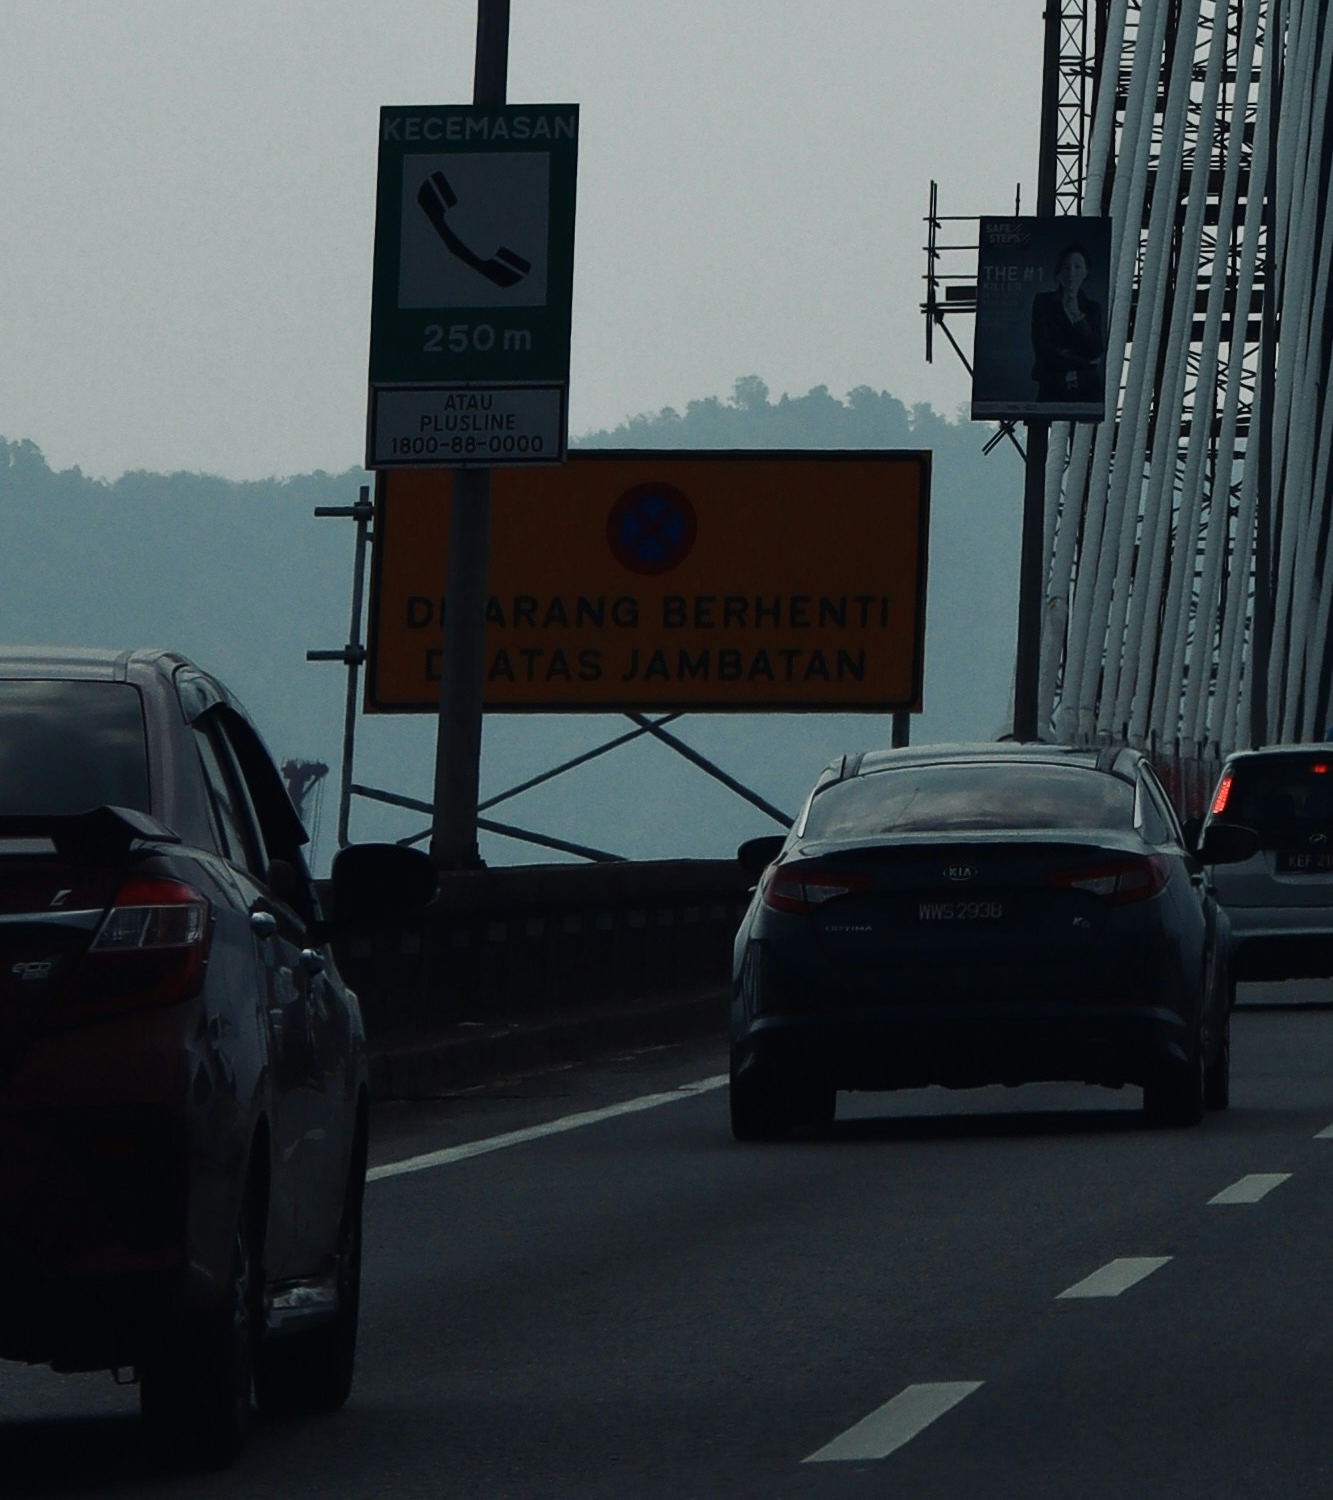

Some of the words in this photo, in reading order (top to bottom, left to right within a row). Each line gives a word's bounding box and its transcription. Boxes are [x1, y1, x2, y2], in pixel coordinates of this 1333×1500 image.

[383, 115, 576, 141] KECEMASAN
[986, 223, 1011, 233] SAFE
[990, 234, 1020, 244] STEPS
[984, 266, 1018, 281] THE
[1024, 266, 1043, 281] #1
[423, 323, 495, 353] 250
[503, 327, 531, 351] m
[444, 394, 493, 412] ATAU
[420, 413, 515, 432] PLUSLINE
[391, 434, 544, 454] 1800-88-0000
[407, 596, 640, 628] DIARANG
[663, 596, 889, 628] BERHENTI
[488, 648, 603, 682] ATAS
[621, 648, 867, 682] JAMBATAN
[948, 867, 971, 877] KIA
